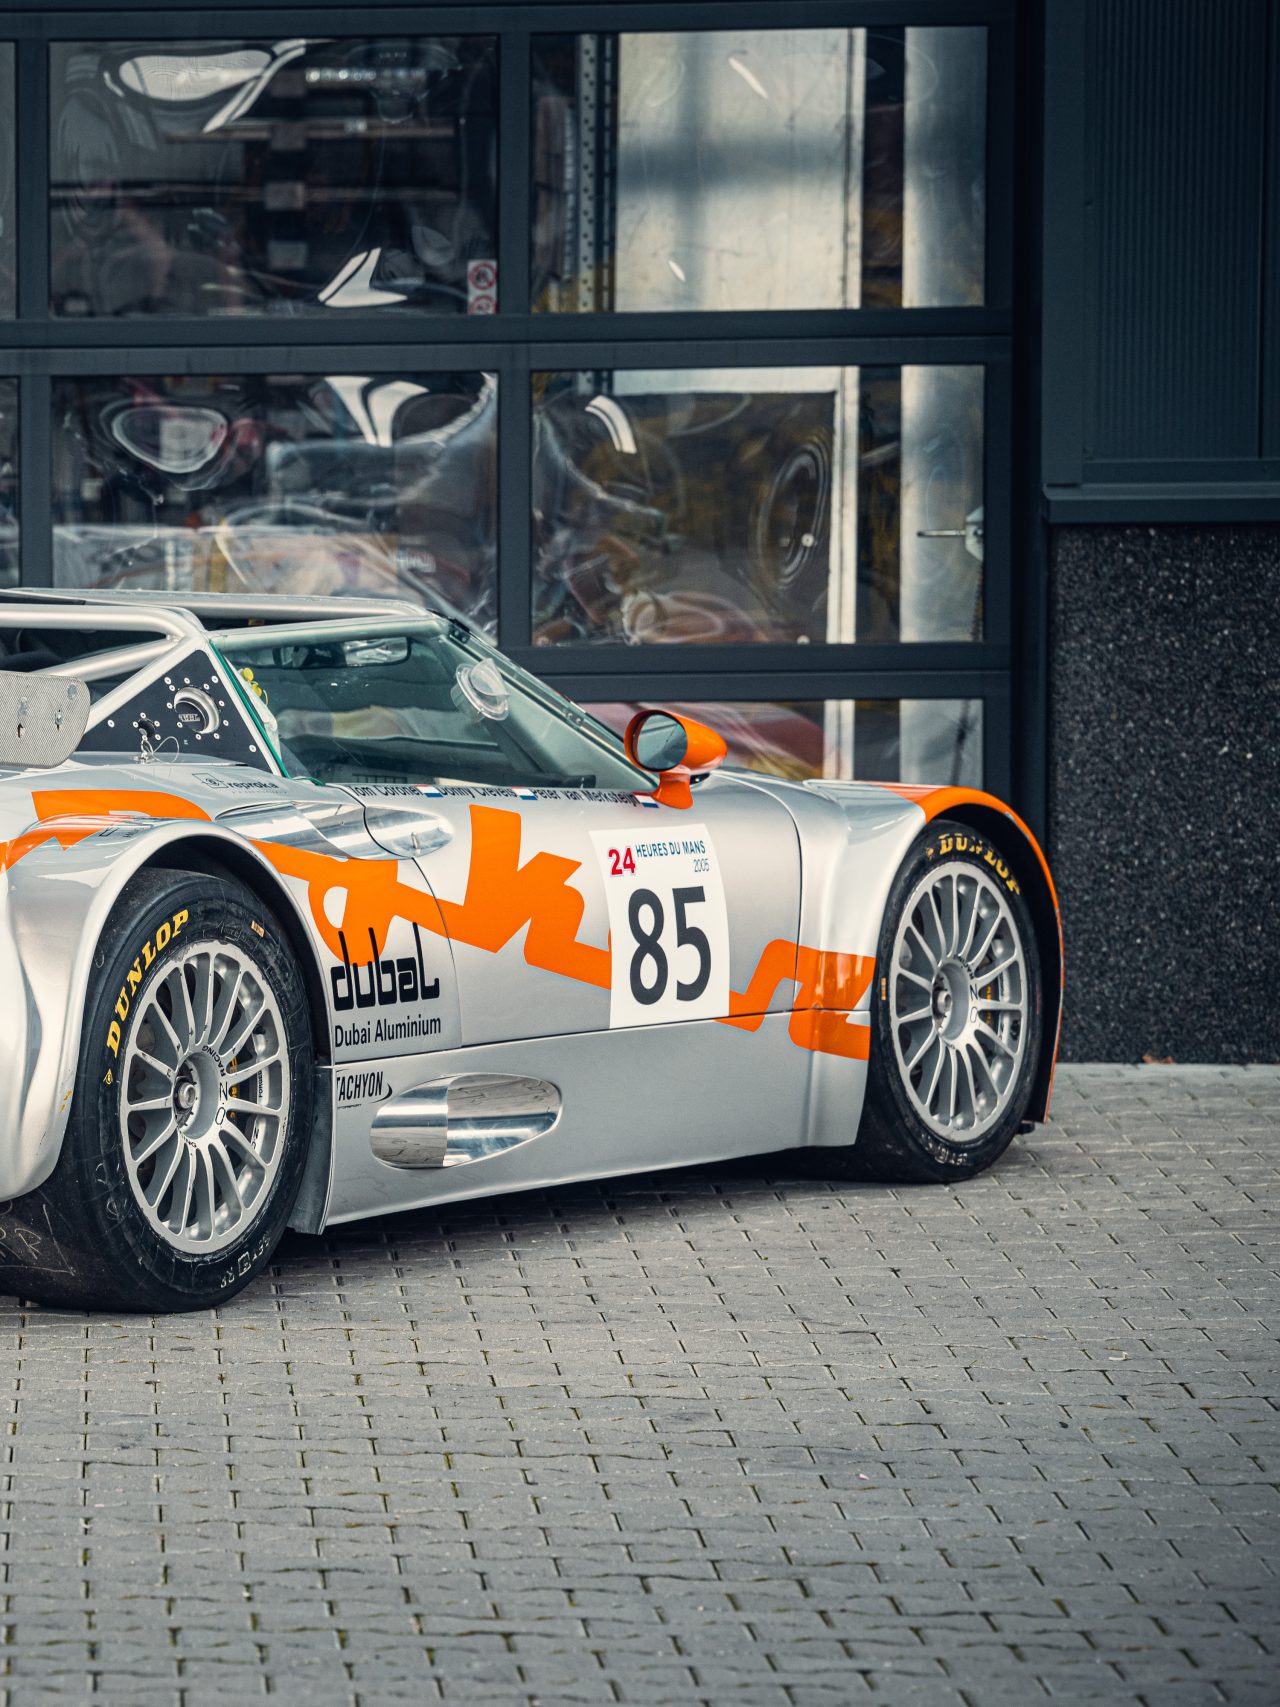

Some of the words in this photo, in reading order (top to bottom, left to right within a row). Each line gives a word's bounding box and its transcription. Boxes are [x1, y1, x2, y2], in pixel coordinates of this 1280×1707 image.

[348, 785, 377, 797] Tom
[561, 790, 582, 801] van
[608, 847, 636, 876] 24
[635, 842, 669, 858] HEURES
[669, 841, 681, 855] DU
[682, 840, 706, 854] MANS
[693, 858, 710, 873] 2005
[628, 886, 711, 1005] 85
[106, 909, 189, 1058] DUNLOP
[335, 1021, 371, 1047] Dubai
[375, 1014, 441, 1042] Aluminium
[202, 1045, 226, 1077] RACING
